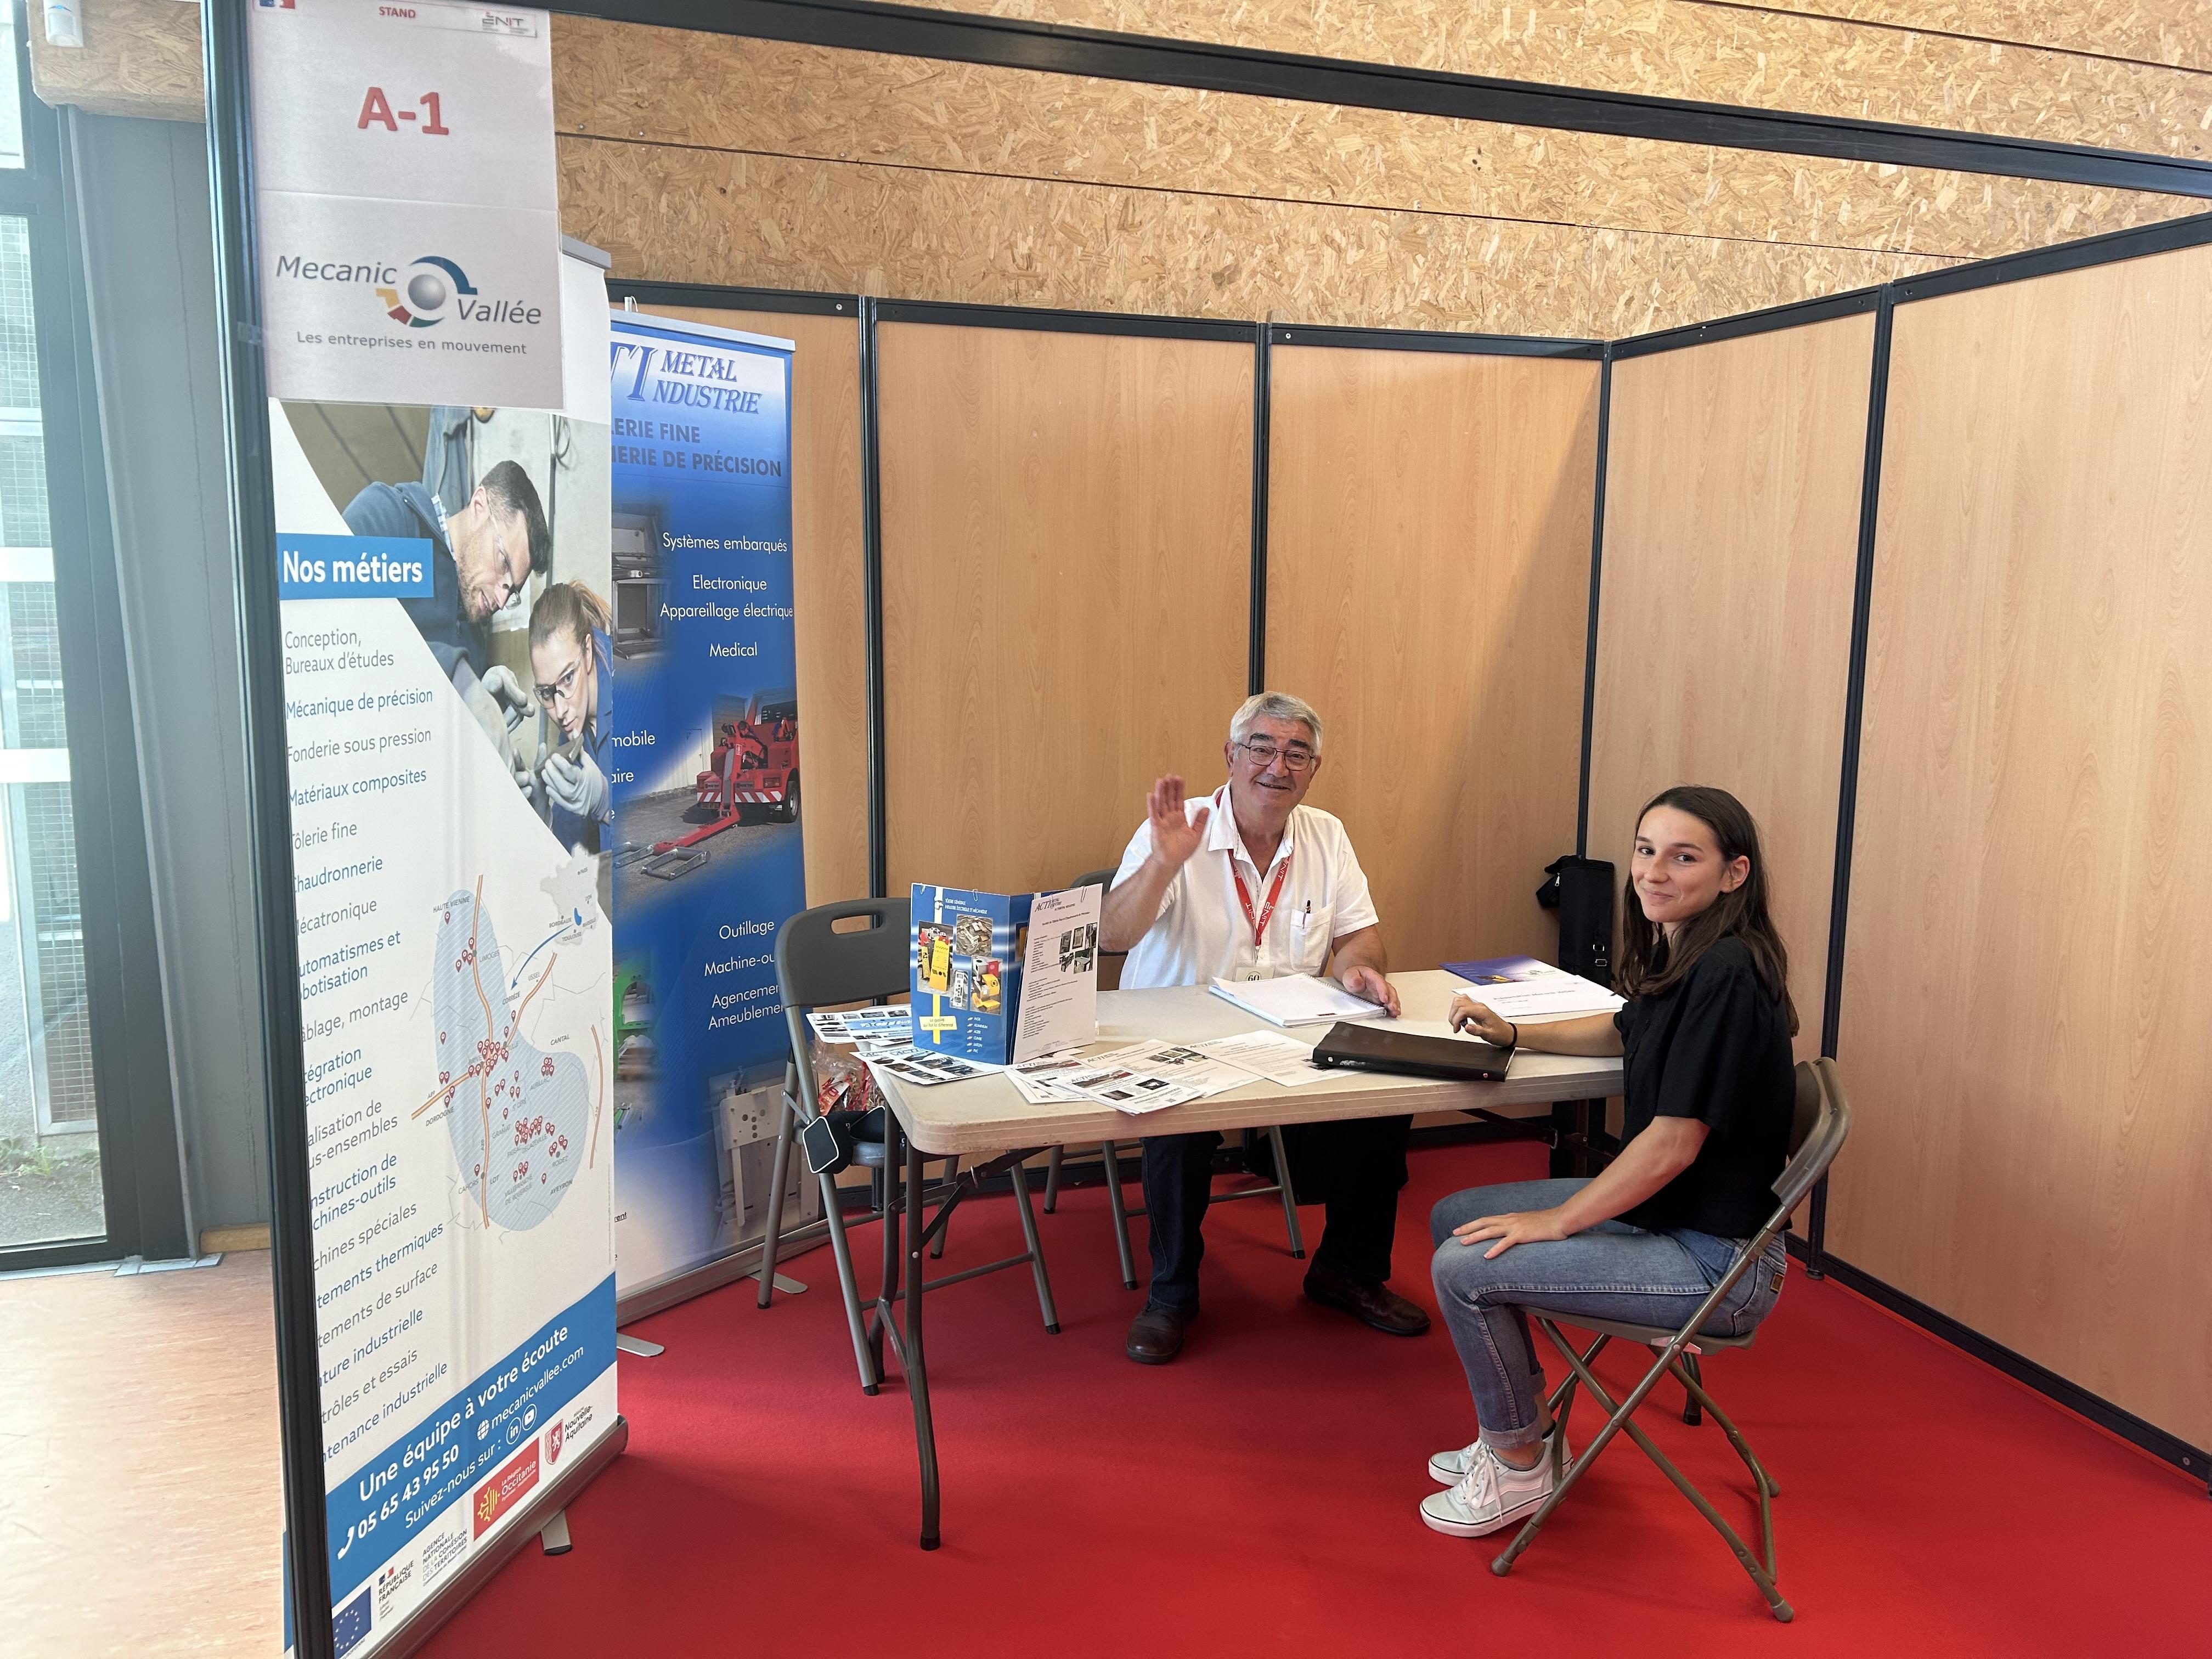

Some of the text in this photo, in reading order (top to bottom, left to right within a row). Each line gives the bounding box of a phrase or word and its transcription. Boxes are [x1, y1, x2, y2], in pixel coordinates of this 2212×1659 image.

[379, 6, 416, 19] STAND
[357, 86, 449, 135] A-1
[276, 255, 397, 284] Mecanic
[457, 300, 541, 324] Vallée
[297, 331, 527, 354] Les entreprises en mouvement
[660, 349, 737, 382] METAL
[660, 422, 701, 443] FINE
[663, 450, 686, 469] DE
[692, 450, 782, 477] PRÉCISION
[663, 532, 787, 554] Systèmes embarqués
[283, 550, 423, 583] Nos métiers
[692, 574, 767, 593] Electronique
[660, 602, 793, 620] Appareillage électrique
[285, 628, 361, 651] Conception,
[709, 641, 758, 657] Medical
[286, 650, 394, 675] Bureaux d'études
[286, 688, 433, 719] Mécanique de précision
[344, 737, 375, 754] sous
[380, 728, 431, 753] pression
[611, 730, 656, 747] mobile
[352, 769, 427, 793] composites
[331, 821, 357, 839] fine
[294, 856, 383, 893] haudronnerie
[297, 900, 377, 935] écatronique
[433, 896, 470, 913] HAUTE VIENNE
[719, 920, 774, 939] Outillage
[299, 930, 401, 978] utomatismes et
[704, 953, 775, 977] Machine-ou
[300, 965, 368, 1001] botisation
[349, 991, 408, 1023] montage
[550, 1034, 570, 1046] CANTAL
[304, 1048, 362, 1084] tégration
[305, 1066, 373, 1107] ectronique
[308, 1099, 382, 1147] alisation de
[426, 1106, 455, 1127] DORDOGNE
[309, 1115, 398, 1170] us-ensembles
[311, 1153, 397, 1210] nstruction de
[458, 1180, 479, 1194] CAHORS
[490, 1175, 500, 1185] LOT
[550, 1180, 573, 1195] AVEYRON
[313, 1175, 396, 1231] chines-outils
[313, 1203, 417, 1271] chines spéciales
[317, 1222, 443, 1309] tements thermiques
[318, 1262, 438, 1348] tements de surface
[353, 1308, 423, 1364] industrielle
[321, 1349, 418, 1424] trôles et essais
[383, 1362, 448, 1419] industrielle
[492, 1346, 584, 1431] mecanicvallee.com
[360, 1327, 568, 1501] Une équipe à votre écoute
[565, 1413, 592, 1442] Aquitaine
[358, 1444, 459, 1539] 05 65 43 95 50
[405, 1460, 476, 1528] Suivez-nous
[478, 1448, 494, 1466] sur
[501, 1460, 537, 1496] Occitanie
[423, 1532, 444, 1557] AGENCE
[423, 1532, 454, 1565] NATIONALE
[434, 1536, 467, 1570] TERRITOIRES
[439, 1528, 467, 1558] COHÉSION
[379, 1560, 414, 1596] RÉPUBLIQUE
[379, 1570, 412, 1604] FRANÇAISE
